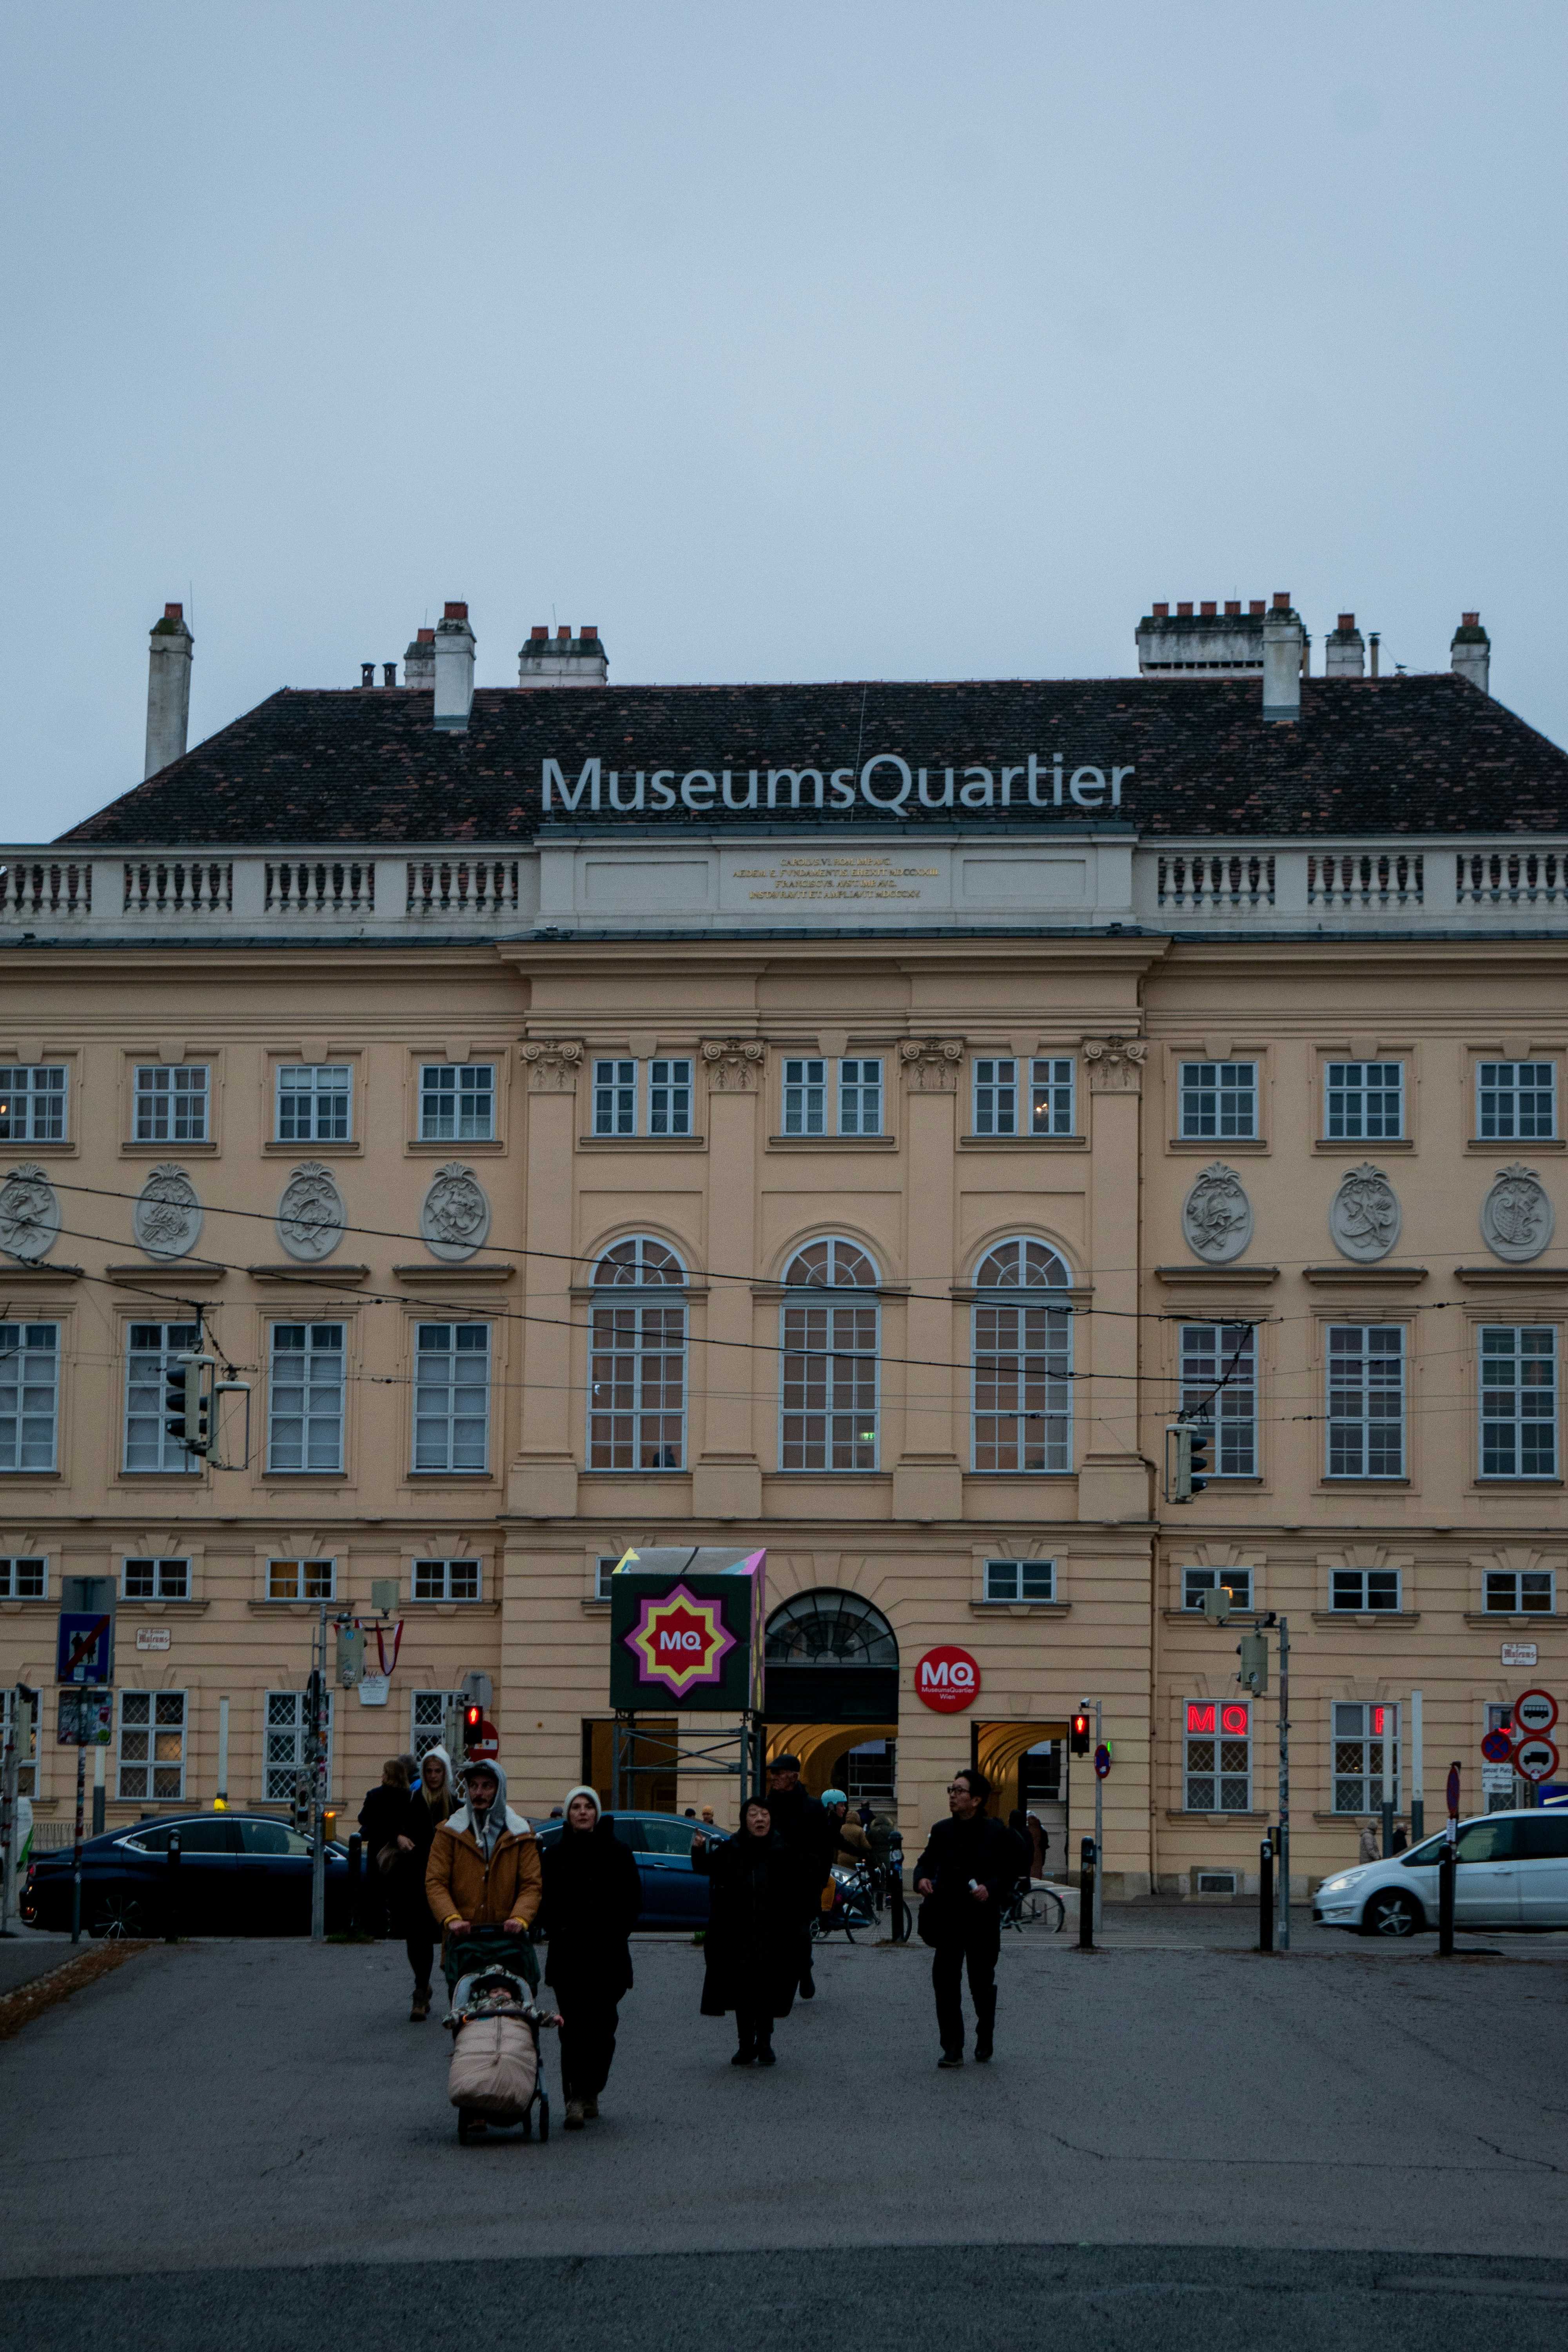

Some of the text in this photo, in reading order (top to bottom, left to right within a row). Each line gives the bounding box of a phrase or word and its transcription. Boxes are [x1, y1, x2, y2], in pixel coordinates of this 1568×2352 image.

[542, 753, 1135, 816] MuseumsQuartier
[660, 1631, 701, 1650] MQ
[922, 1661, 975, 1686] MQ
